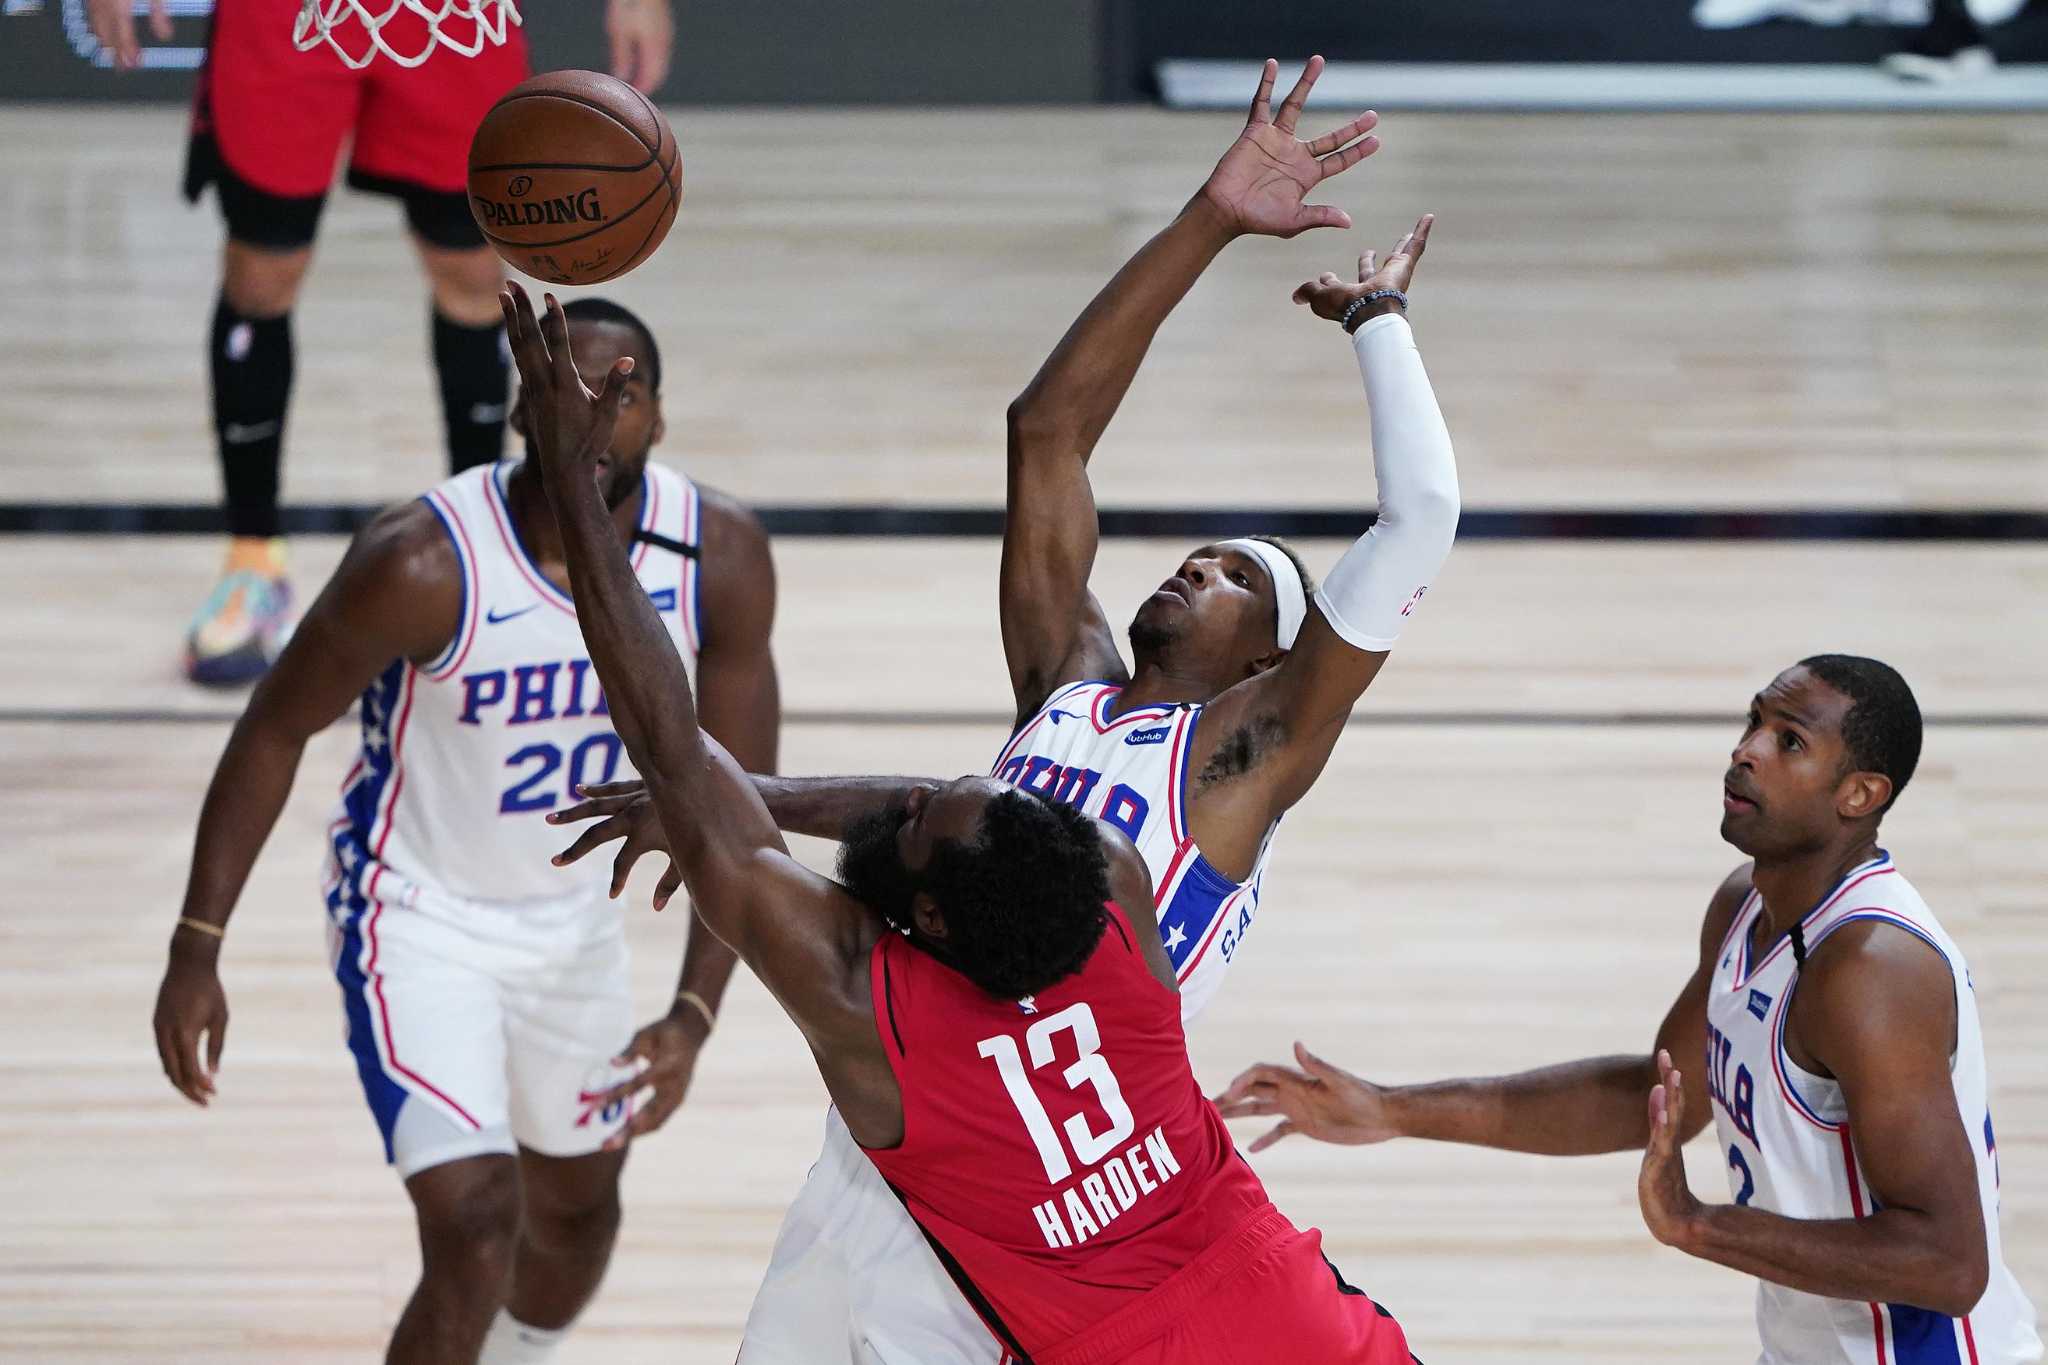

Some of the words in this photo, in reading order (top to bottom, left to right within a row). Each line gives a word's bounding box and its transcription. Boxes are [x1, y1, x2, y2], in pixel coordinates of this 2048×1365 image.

[475, 188, 604, 226] PALDING
[498, 731, 623, 814] 20
[977, 1002, 1135, 1185] 13
[1032, 1126, 1181, 1249] HARDEN
